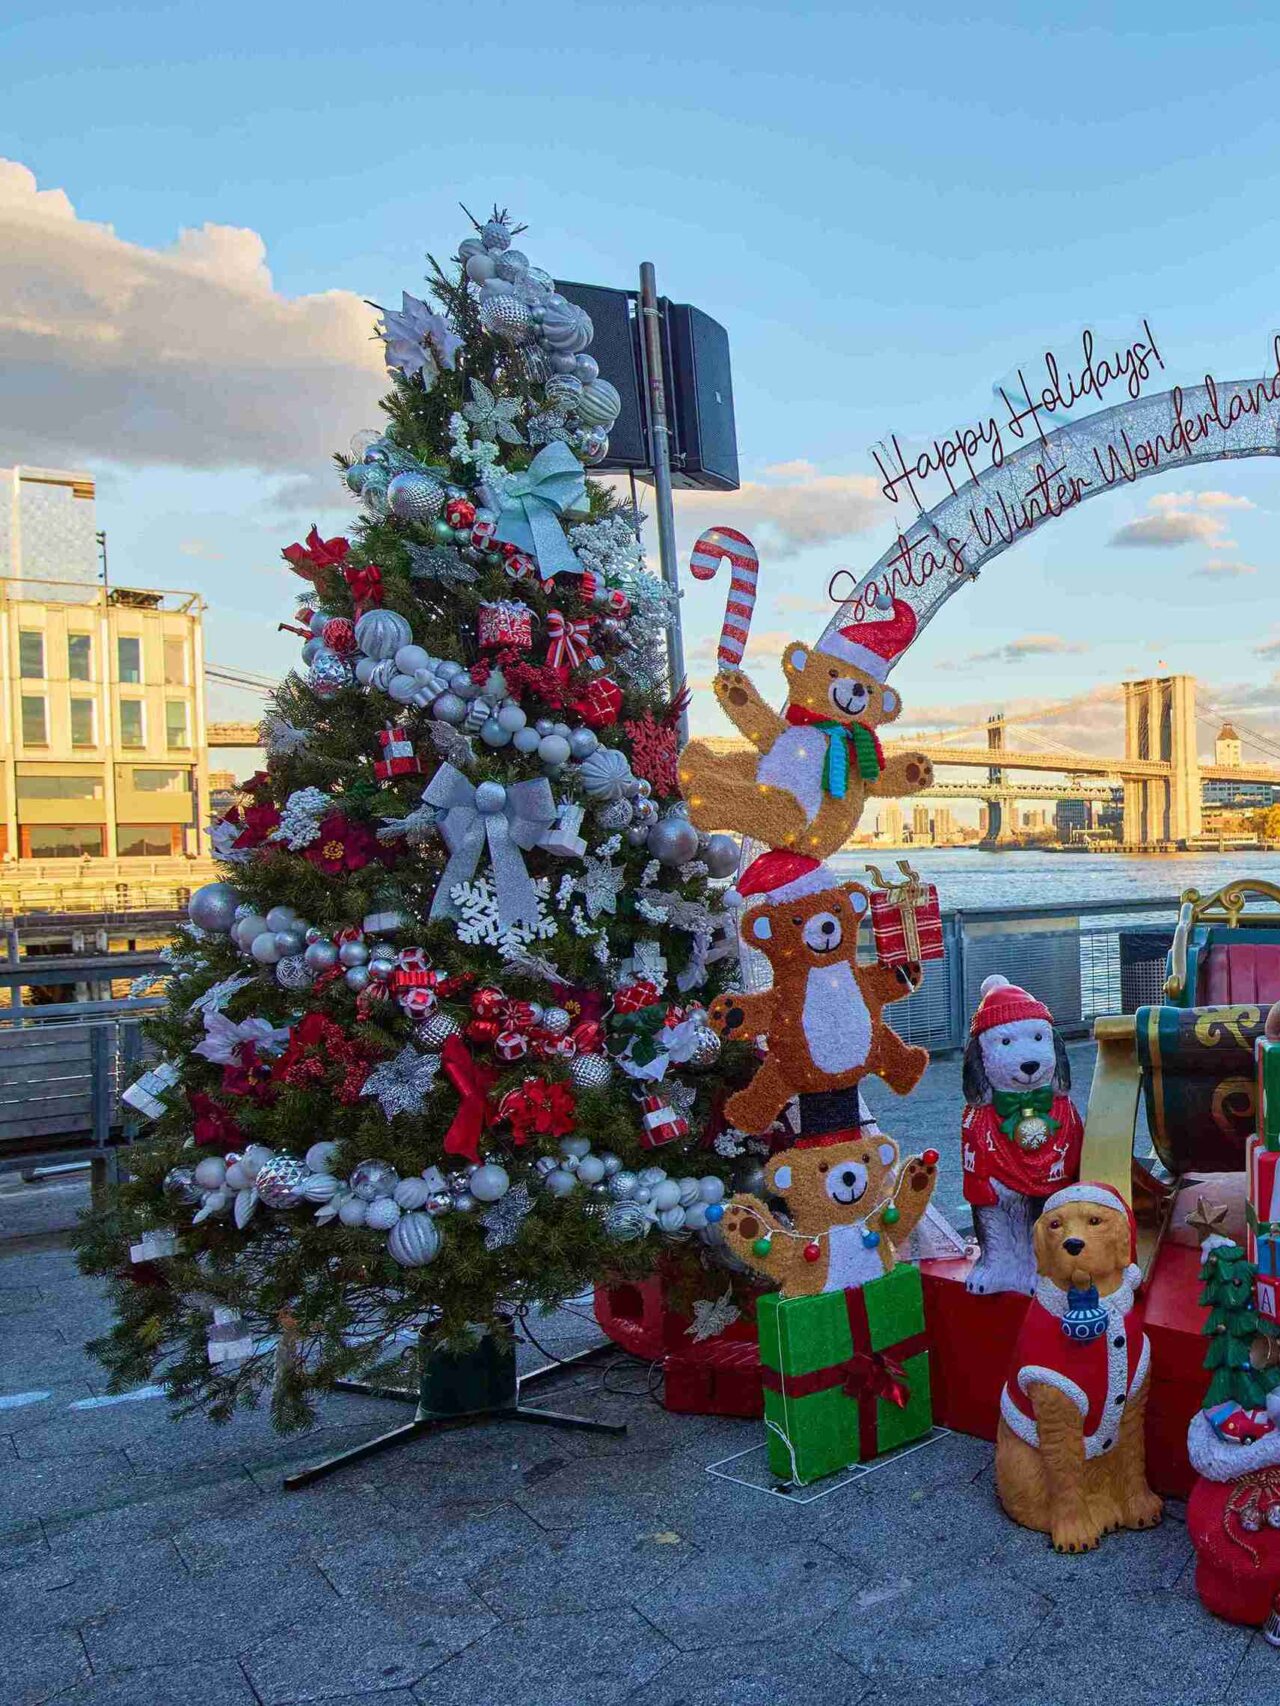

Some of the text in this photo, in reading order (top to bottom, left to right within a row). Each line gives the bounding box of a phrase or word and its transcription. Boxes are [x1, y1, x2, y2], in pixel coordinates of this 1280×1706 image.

[871, 319, 1165, 509] Happy Holidays!
[828, 524, 967, 621] Santa's
[969, 464, 1093, 545] Winter
[1261, 1287, 1273, 1314] A
